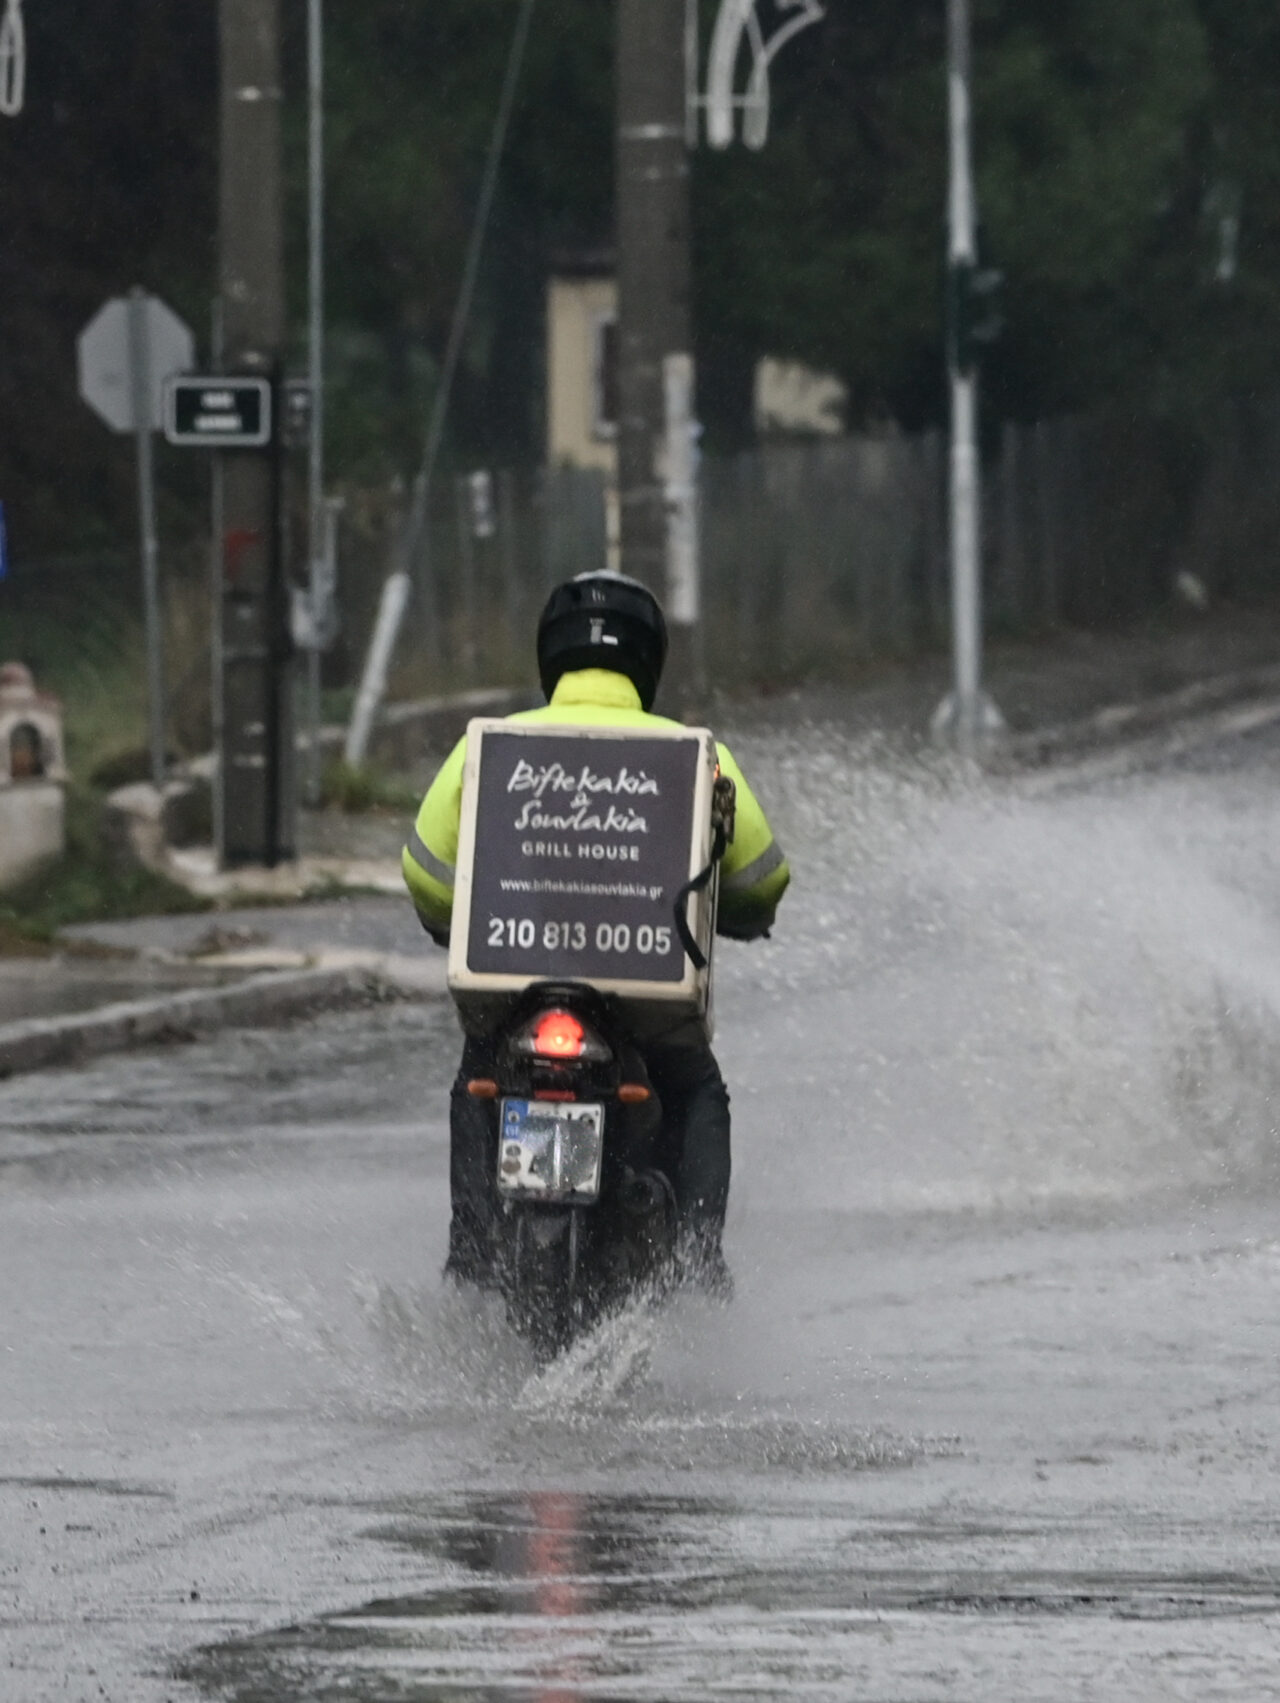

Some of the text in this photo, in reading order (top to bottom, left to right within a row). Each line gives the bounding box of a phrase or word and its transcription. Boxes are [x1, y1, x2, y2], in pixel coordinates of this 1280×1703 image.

[507, 758, 660, 798] Biftekakia
[514, 799, 649, 834] Souvlakia
[521, 840, 640, 861] GRILL HOUSE
[500, 878, 663, 901] www.biftekakiasouvlakia.gr
[487, 917, 672, 954] 210 813 00 05
